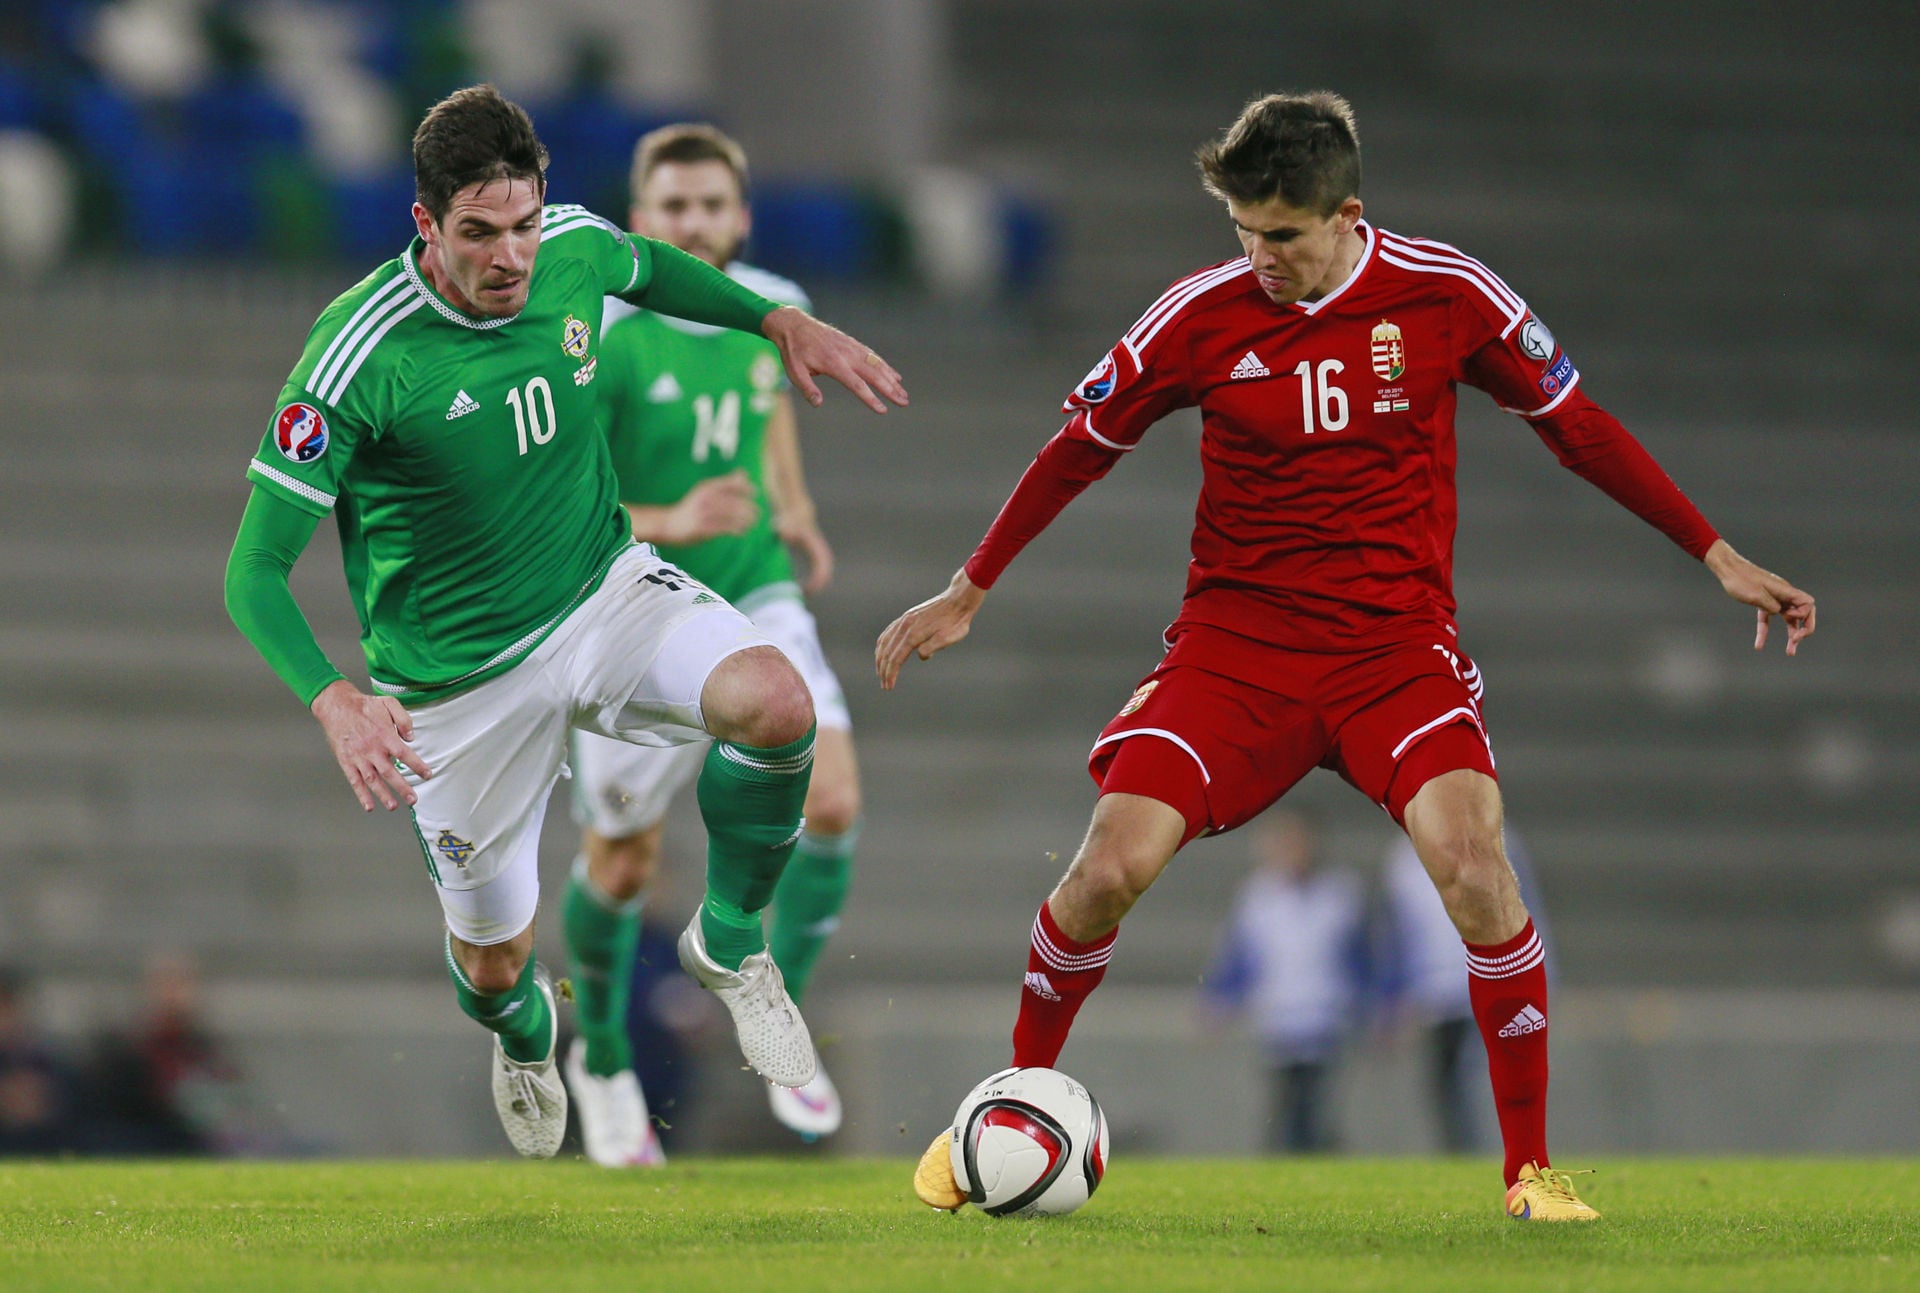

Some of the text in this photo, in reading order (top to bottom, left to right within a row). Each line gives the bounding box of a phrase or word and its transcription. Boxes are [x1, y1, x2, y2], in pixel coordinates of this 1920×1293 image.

[1230, 367, 1271, 380] adidas
[1293, 359, 1349, 434] 16
[446, 401, 481, 421] adidas
[505, 376, 556, 456] 10
[692, 390, 740, 463] 14
